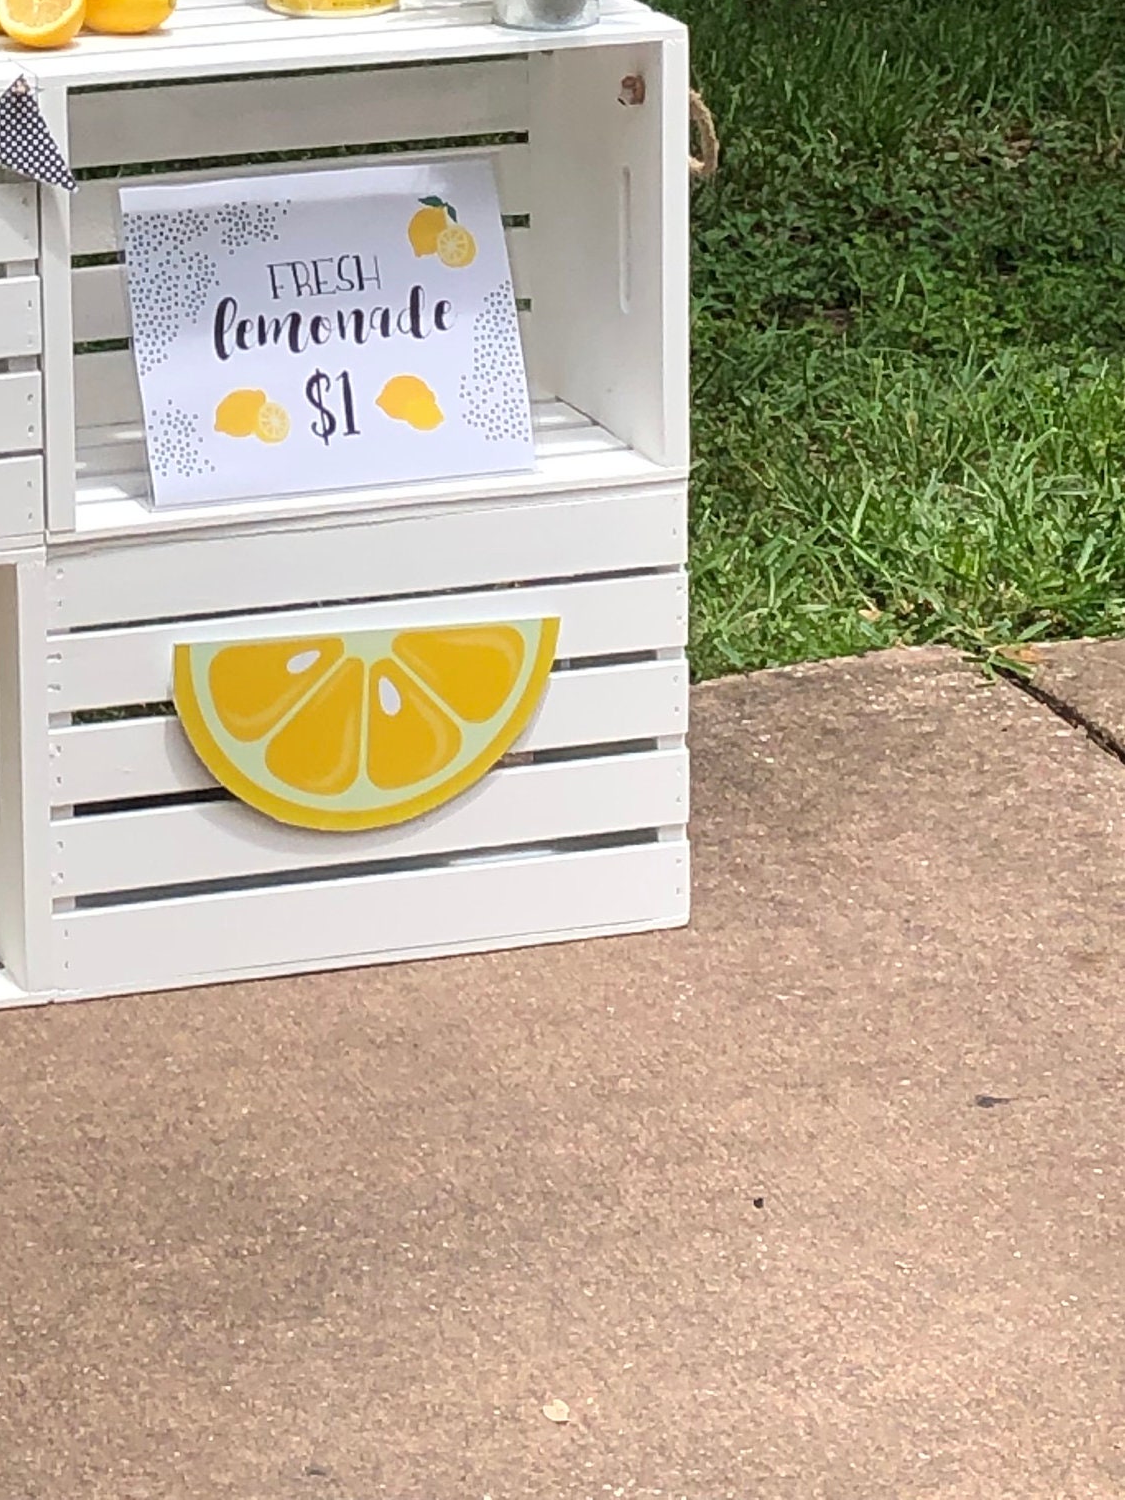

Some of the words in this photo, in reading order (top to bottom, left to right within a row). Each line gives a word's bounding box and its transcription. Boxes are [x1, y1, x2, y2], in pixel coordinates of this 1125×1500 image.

[267, 254, 383, 300] FRESH
[213, 284, 456, 361] lemonade
[305, 367, 361, 446] $1
